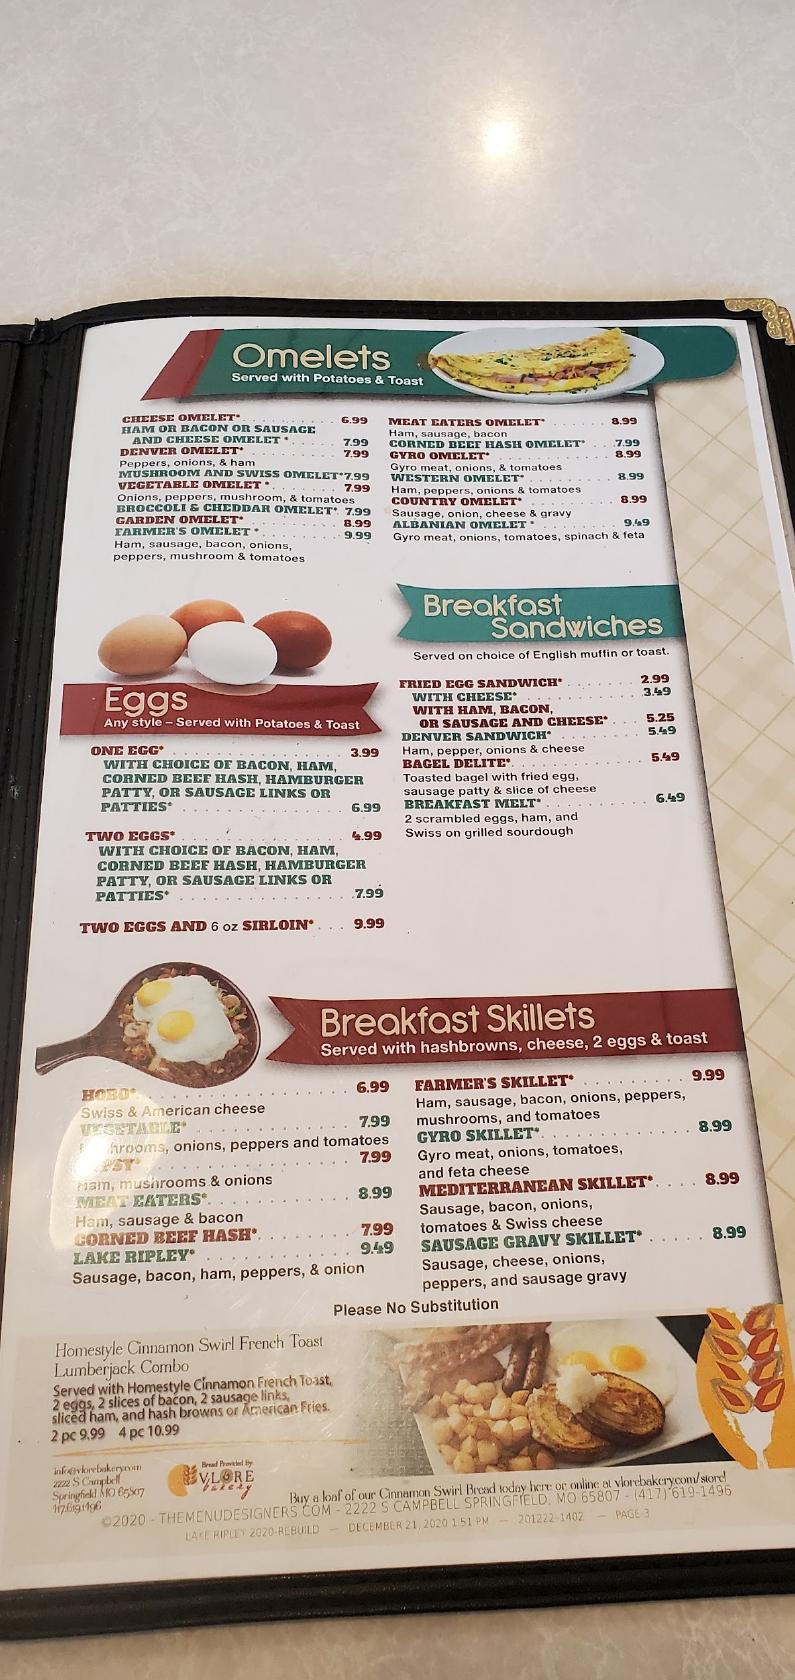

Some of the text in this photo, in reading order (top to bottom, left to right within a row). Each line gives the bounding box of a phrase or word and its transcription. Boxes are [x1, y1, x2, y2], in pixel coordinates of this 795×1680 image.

[233, 343, 390, 370] Omelets
[232, 373, 277, 382] Served
[282, 373, 309, 382] with
[314, 374, 371, 384] Potatoes
[388, 377, 423, 385] Toast
[122, 415, 174, 423] CHEESE
[389, 418, 427, 426] MEAT
[122, 425, 315, 434] HAM OR BACON OR SAUSAGE
[421, 430, 470, 439] sausage,
[474, 430, 507, 438] bacon
[120, 460, 170, 469] Peppers,
[230, 459, 255, 467] ham
[391, 464, 417, 472] Gyro
[421, 464, 452, 472] meat,
[455, 463, 495, 472] onions,
[510, 463, 562, 471] tomatoes
[115, 540, 292, 551] Ham, sausage, bacon, onions,
[113, 553, 165, 562] peppers,
[170, 552, 233, 561] mushroom
[250, 553, 305, 562] tomatoes
[424, 594, 562, 616] Breakfast
[491, 616, 663, 639] Sandwiches
[414, 648, 670, 660] Served on choice of English muffin or toast.
[400, 680, 442, 688] FRIED
[446, 680, 474, 688] EGG
[641, 675, 669, 684] 2.99
[105, 688, 187, 716] Eggs
[413, 704, 553, 716] WITH HAM, BACON,
[104, 718, 128, 728] Any
[132, 718, 162, 728] style
[176, 718, 220, 727] Served
[224, 718, 251, 727] with
[256, 719, 311, 729] Potatoes
[326, 720, 360, 729] Toast
[420, 719, 438, 728] OR
[443, 718, 508, 728] SAUSAGE
[512, 718, 543, 727] AND
[646, 713, 674, 722] 5.25
[91, 746, 123, 755] ONE
[351, 748, 379, 757] 3.99
[103, 774, 363, 785] CORNED BEEF HASH, HAMBURGER
[405, 812, 578, 824] 2 scrambled eggs, ham, and
[406, 826, 573, 839] Swiss on grilled sourdough
[80, 922, 119, 933] TWO
[124, 921, 166, 932] EGGS
[170, 921, 207, 931] AND
[211, 922, 218, 931] 6
[223, 923, 238, 931] oz
[354, 918, 384, 928] 9.99
[321, 1002, 595, 1037] Breakfast Skillets
[321, 1042, 379, 1056] Served
[382, 1042, 414, 1055] with
[420, 1039, 523, 1055] hashbrowns,
[527, 1037, 589, 1053] cheese,
[593, 1036, 602, 1048] 2
[608, 1035, 647, 1050] eggs
[666, 1032, 708, 1045] toast
[415, 1078, 496, 1091] FARMER'S
[692, 1069, 725, 1081] 9.99
[421, 1220, 487, 1234] tomatoes
[505, 1217, 547, 1230] Swiss
[552, 1215, 602, 1228] cheese
[73, 1272, 140, 1285] Sausage,
[146, 1269, 195, 1282] bacon,
[201, 1268, 235, 1280] ham,
[240, 1266, 304, 1280] peppers,
[324, 1263, 364, 1275] onion
[334, 1299, 498, 1316] Please No Substitution
[56, 1334, 323, 1360] Homestyle Cinnamon Swirl French Toast
[55, 1359, 189, 1381] Lumberjack Combo
[51, 1424, 180, 1444] 2 pc 9.99 4 pc 10.99
